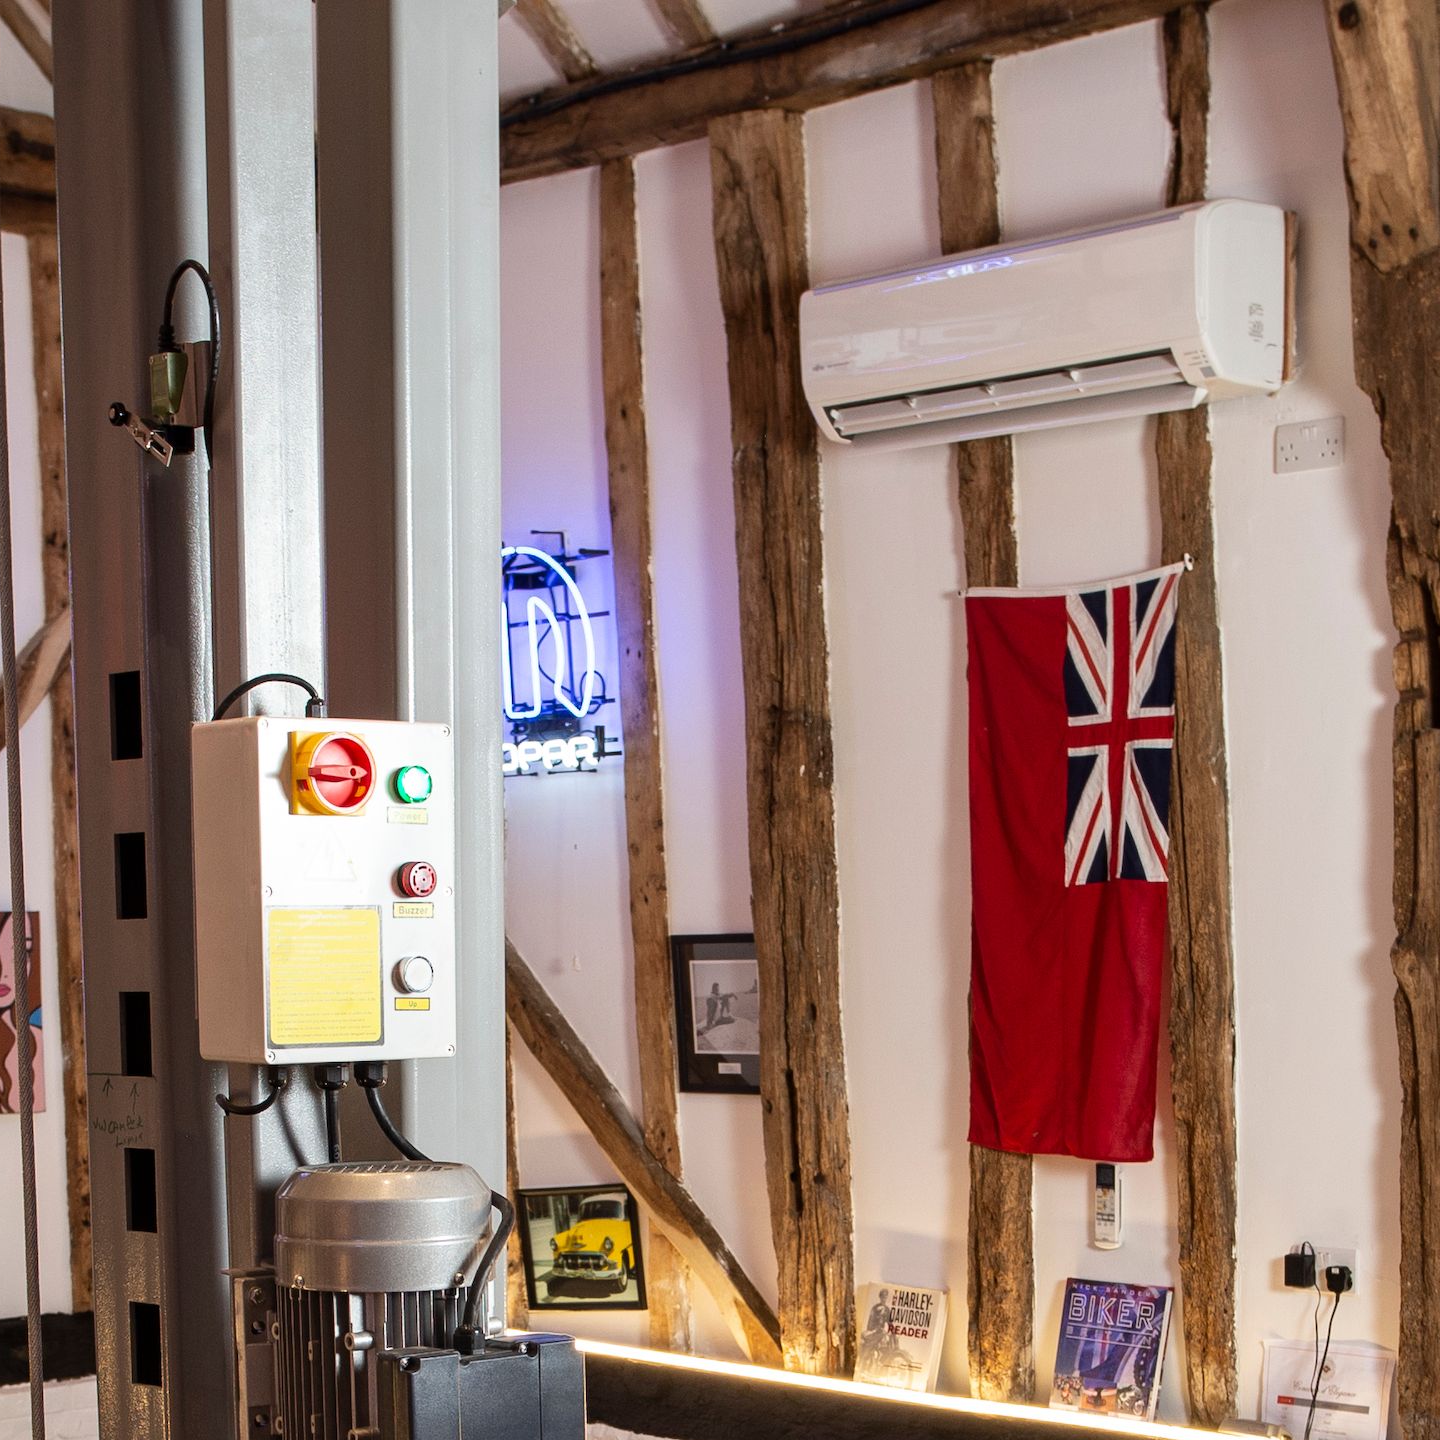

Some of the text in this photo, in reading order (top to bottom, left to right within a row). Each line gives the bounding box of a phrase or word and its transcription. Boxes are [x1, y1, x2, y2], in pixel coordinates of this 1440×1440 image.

[398, 904, 429, 915] Buzzer
[407, 1000, 418, 1008] Up
[1072, 1283, 1152, 1298] NICK SANDER
[898, 1291, 933, 1311] HARLEY-
[889, 1307, 932, 1328] DAVIDSON
[1068, 1293, 1155, 1331] BIKER
[887, 1324, 928, 1340] READER
[1066, 1325, 1152, 1345] BRITAIN
